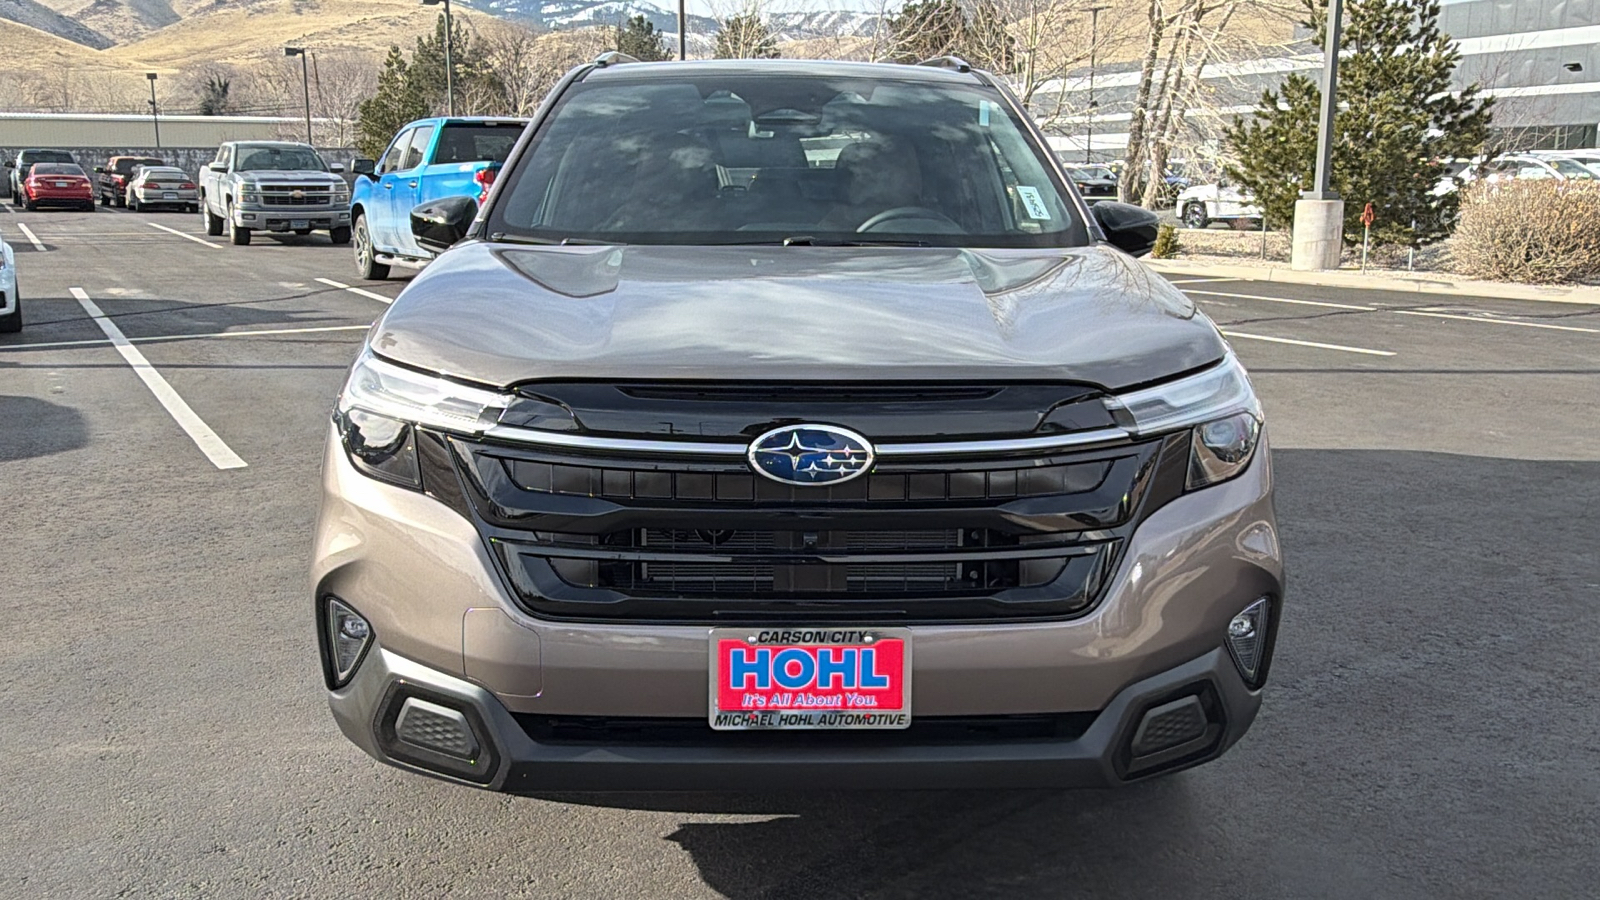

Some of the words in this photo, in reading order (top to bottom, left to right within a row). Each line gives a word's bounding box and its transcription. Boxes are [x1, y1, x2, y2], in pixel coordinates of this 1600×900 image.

[757, 631, 827, 643] CARSON
[831, 631, 868, 643] CITY
[730, 648, 889, 689] HOHL
[741, 692, 766, 707] It's
[768, 692, 792, 707] All
[793, 692, 842, 707] About
[845, 692, 878, 706] You.
[714, 714, 774, 727] MICHAEL
[778, 714, 814, 726] HOHL
[817, 714, 906, 726] AUTOMOTIVE
